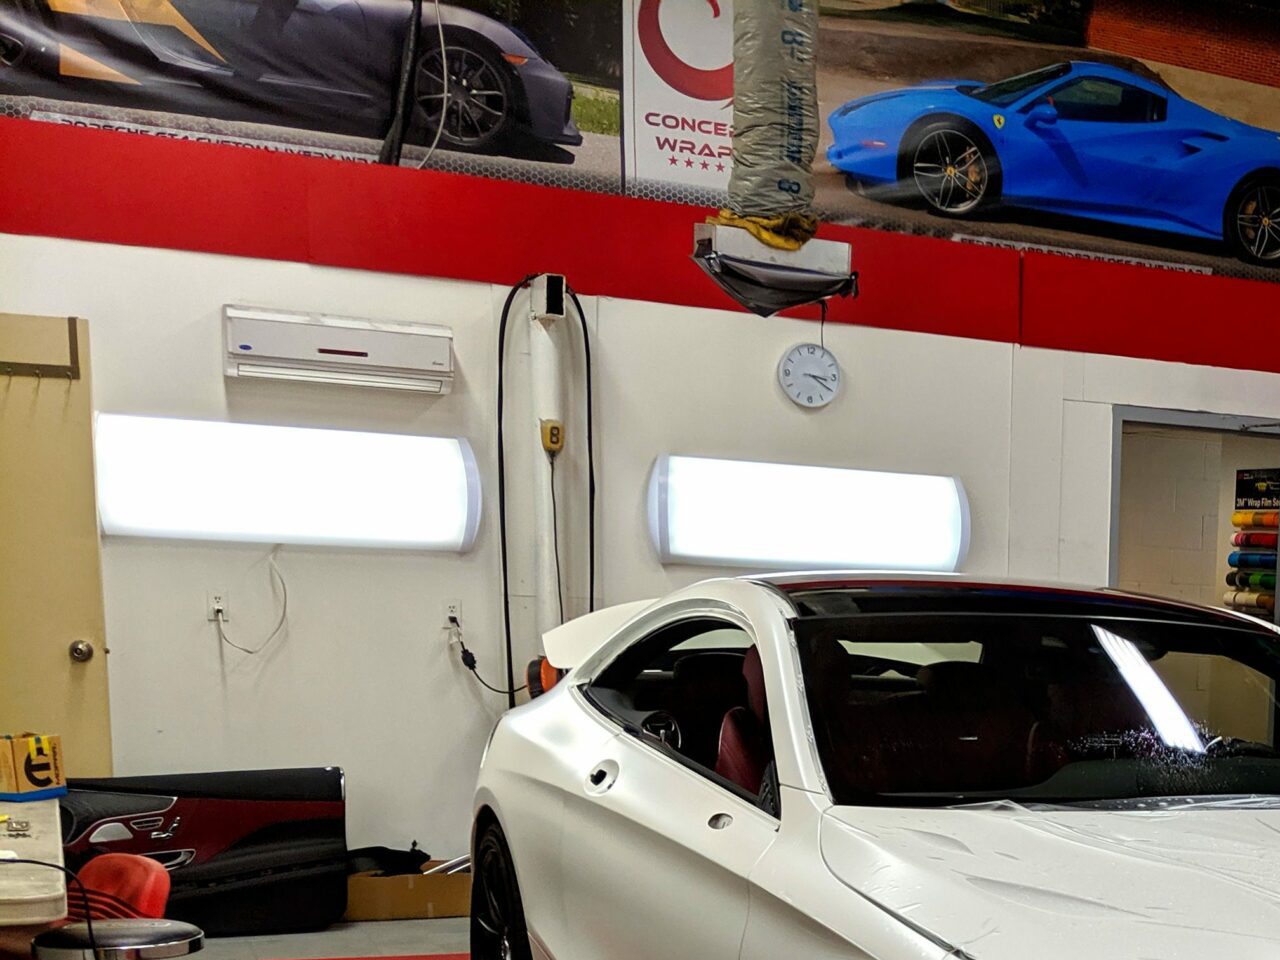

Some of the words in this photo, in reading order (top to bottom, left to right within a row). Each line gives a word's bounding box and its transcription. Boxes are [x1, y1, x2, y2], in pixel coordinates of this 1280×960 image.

[644, 112, 734, 138] CONCE
[655, 136, 733, 158] WRAP
[807, 346, 816, 355] 12
[830, 373, 837, 382] 3
